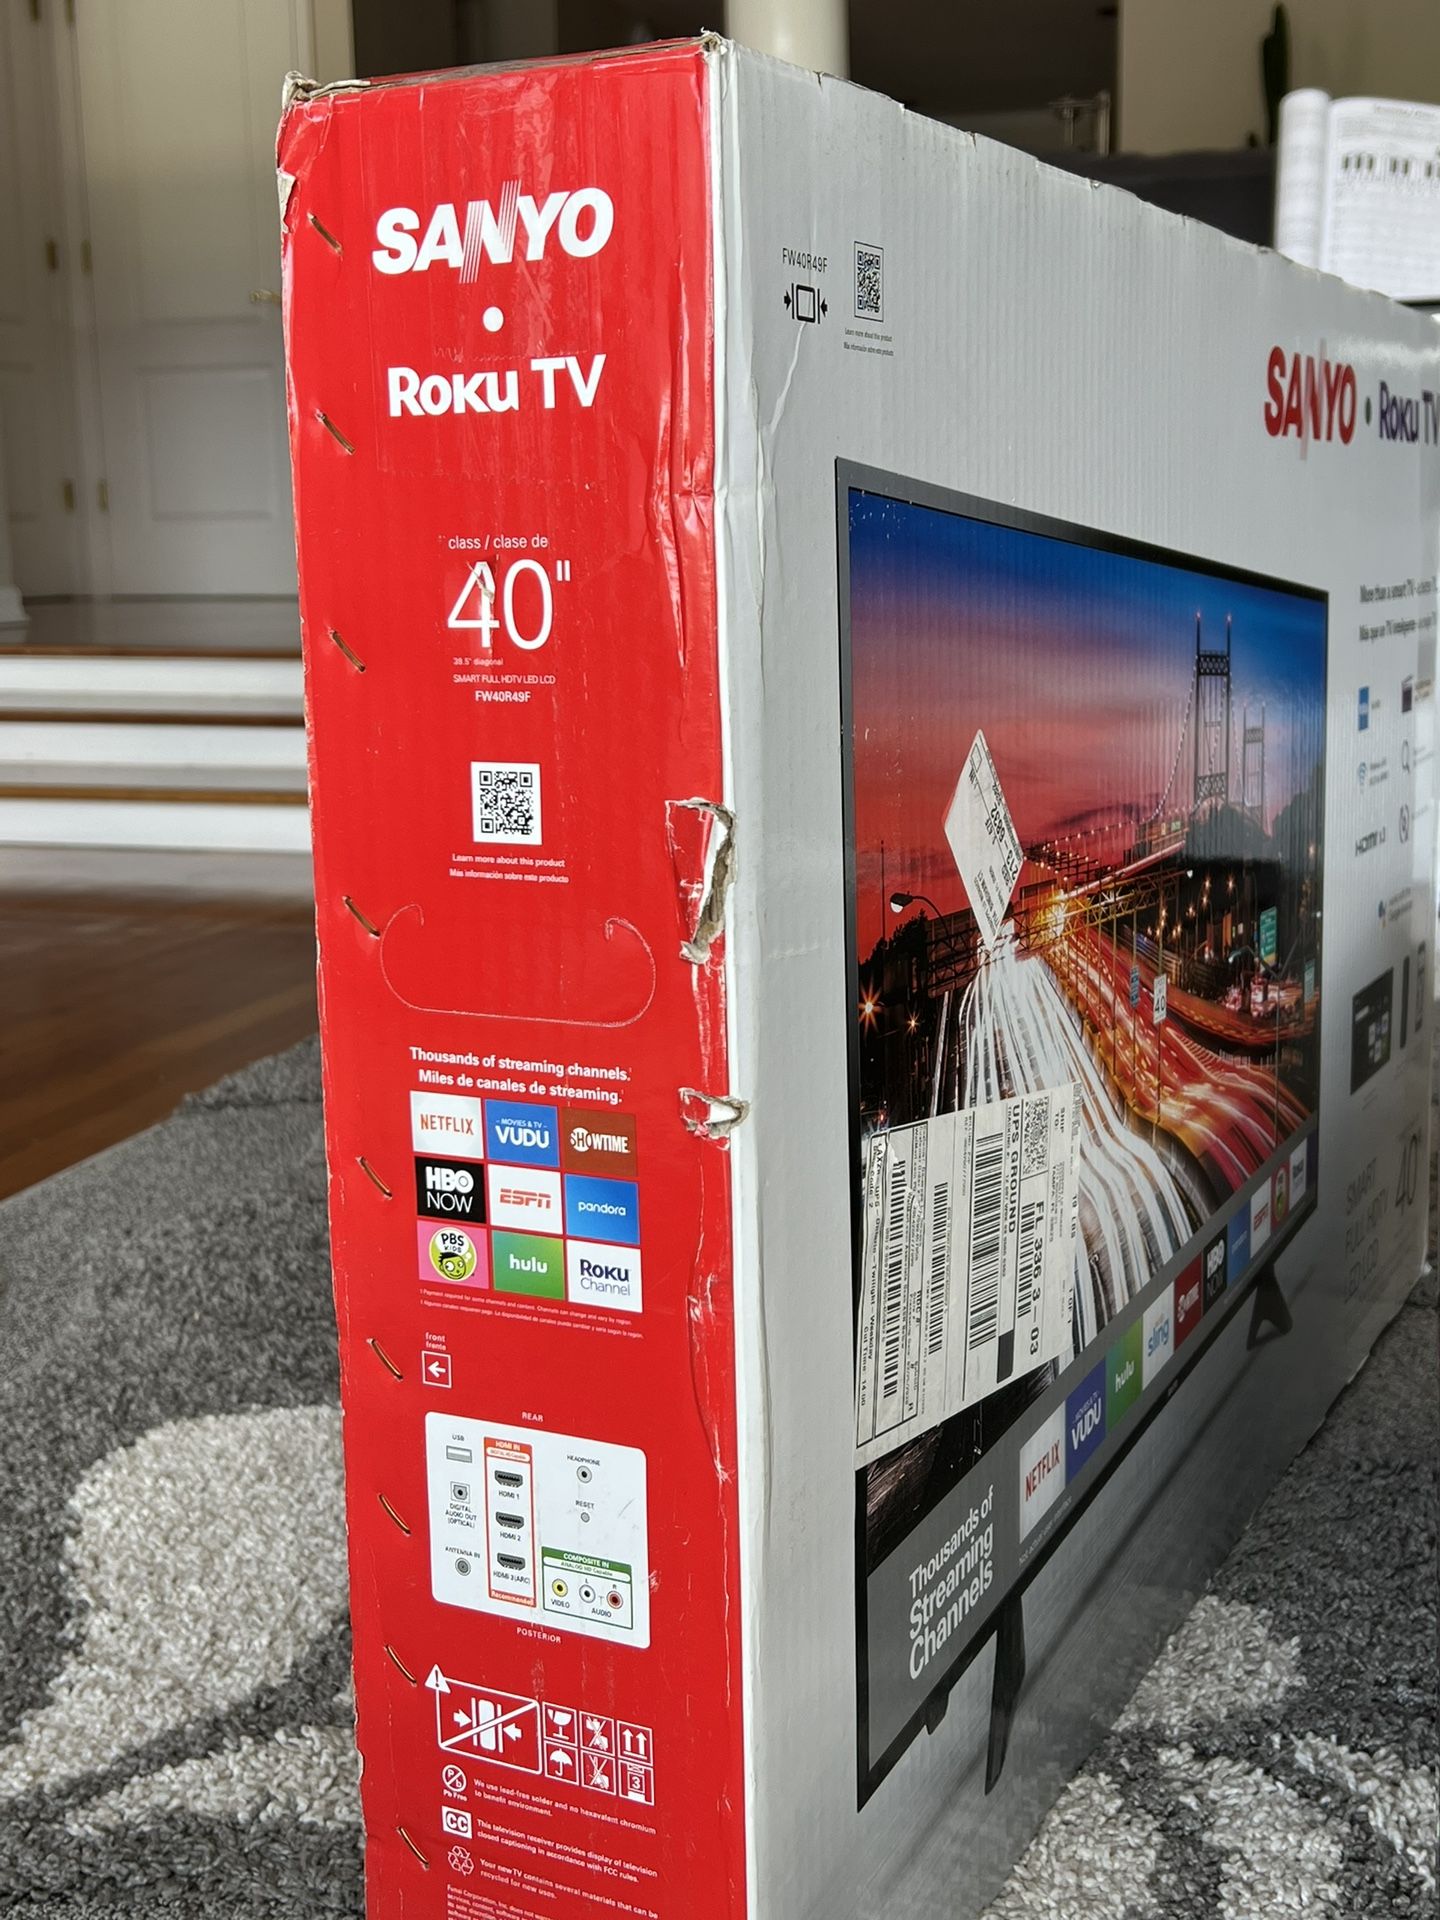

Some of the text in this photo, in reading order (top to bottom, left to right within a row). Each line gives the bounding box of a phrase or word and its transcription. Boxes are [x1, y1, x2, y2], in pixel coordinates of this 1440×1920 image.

[372, 180, 614, 284] SANYO
[782, 247, 828, 273] FW40R49F
[388, 354, 606, 417] Roku TV
[1264, 337, 1357, 461] SANYO
[1379, 380, 1419, 443] Roku
[448, 534, 548, 550] class / clase de
[447, 558, 571, 650] 40"
[473, 657, 503, 667] diagonal
[453, 674, 556, 685] SMART FULL HDTV LED LCD
[475, 690, 531, 703] FW40R49F
[452, 853, 566, 869] Learn more about this product
[504, 871, 522, 881] sobre
[538, 874, 569, 884] producto
[1154, 994, 1167, 1013] 40
[409, 1046, 480, 1067] Thousands
[482, 1054, 495, 1068] of
[498, 1056, 565, 1077] streaming
[418, 1069, 454, 1086] Miles
[457, 1073, 473, 1088] de
[476, 1076, 527, 1094] canales
[529, 1081, 546, 1095] de
[420, 1113, 474, 1136] NETFLIX
[501, 1118, 528, 1128] MOVIES
[534, 1121, 543, 1129] TV
[1010, 1103, 1021, 1144] UPS
[495, 1125, 550, 1149] VUDU
[570, 1127, 630, 1153] SHOWTIME
[425, 1166, 474, 1194] HBO
[499, 1187, 552, 1209] ESPN
[1004, 1148, 1021, 1235] GROUND
[426, 1191, 474, 1213] NOW
[577, 1200, 627, 1217] pandora
[1034, 1199, 1045, 1230] FL
[441, 1232, 464, 1247] PBS
[509, 1254, 548, 1274] hulu
[1031, 1235, 1044, 1280] 336
[580, 1259, 630, 1283] Roku
[580, 1277, 631, 1297] Channel
[425, 1332, 446, 1343] front
[425, 1341, 446, 1351] frente
[1148, 1317, 1170, 1357] sling
[1115, 1359, 1135, 1393] hulu
[521, 1411, 544, 1423] REAR
[1071, 1397, 1102, 1450] VUDU
[451, 1434, 465, 1442] USB
[495, 1440, 512, 1449] HDMI
[567, 1454, 601, 1466] HEADPHONE
[1025, 1439, 1060, 1503] NETFLIX
[498, 1490, 515, 1499] HDMI
[575, 1499, 595, 1510] RESET
[445, 1510, 464, 1519] AUDIO
[449, 1503, 472, 1513] DIGITAL
[500, 1531, 516, 1541] HDMI
[908, 1484, 994, 1599] Thousands of
[445, 1546, 473, 1557] ANTENNA
[563, 1552, 609, 1569] COMPOSITE IN
[493, 1571, 510, 1580] HDMI
[909, 1522, 994, 1640] Streaming
[550, 1598, 570, 1609] VIDEO
[591, 1606, 612, 1618] AUDIO
[909, 1559, 993, 1680] Channels
[516, 1626, 561, 1644] POSTERIOR
[632, 1776, 641, 1790] 3
[453, 1790, 467, 1802] Free
[474, 1789, 553, 1817] to benefit environment.
[473, 1778, 657, 1835] We use lead-free solder and no hexavalent chromium
[446, 1812, 469, 1832] CC
[477, 1818, 658, 1878] This television receiver provides display of television
[477, 1830, 499, 1842] closed
[500, 1836, 536, 1854] captioning
[538, 1847, 545, 1855] in
[546, 1850, 586, 1867] accordance
[603, 1865, 618, 1877] FCC
[619, 1871, 639, 1883] rules.
[480, 1870, 557, 1899] recycled for new uses.
[480, 1858, 658, 1919] Your new TV contains several materials that can be
